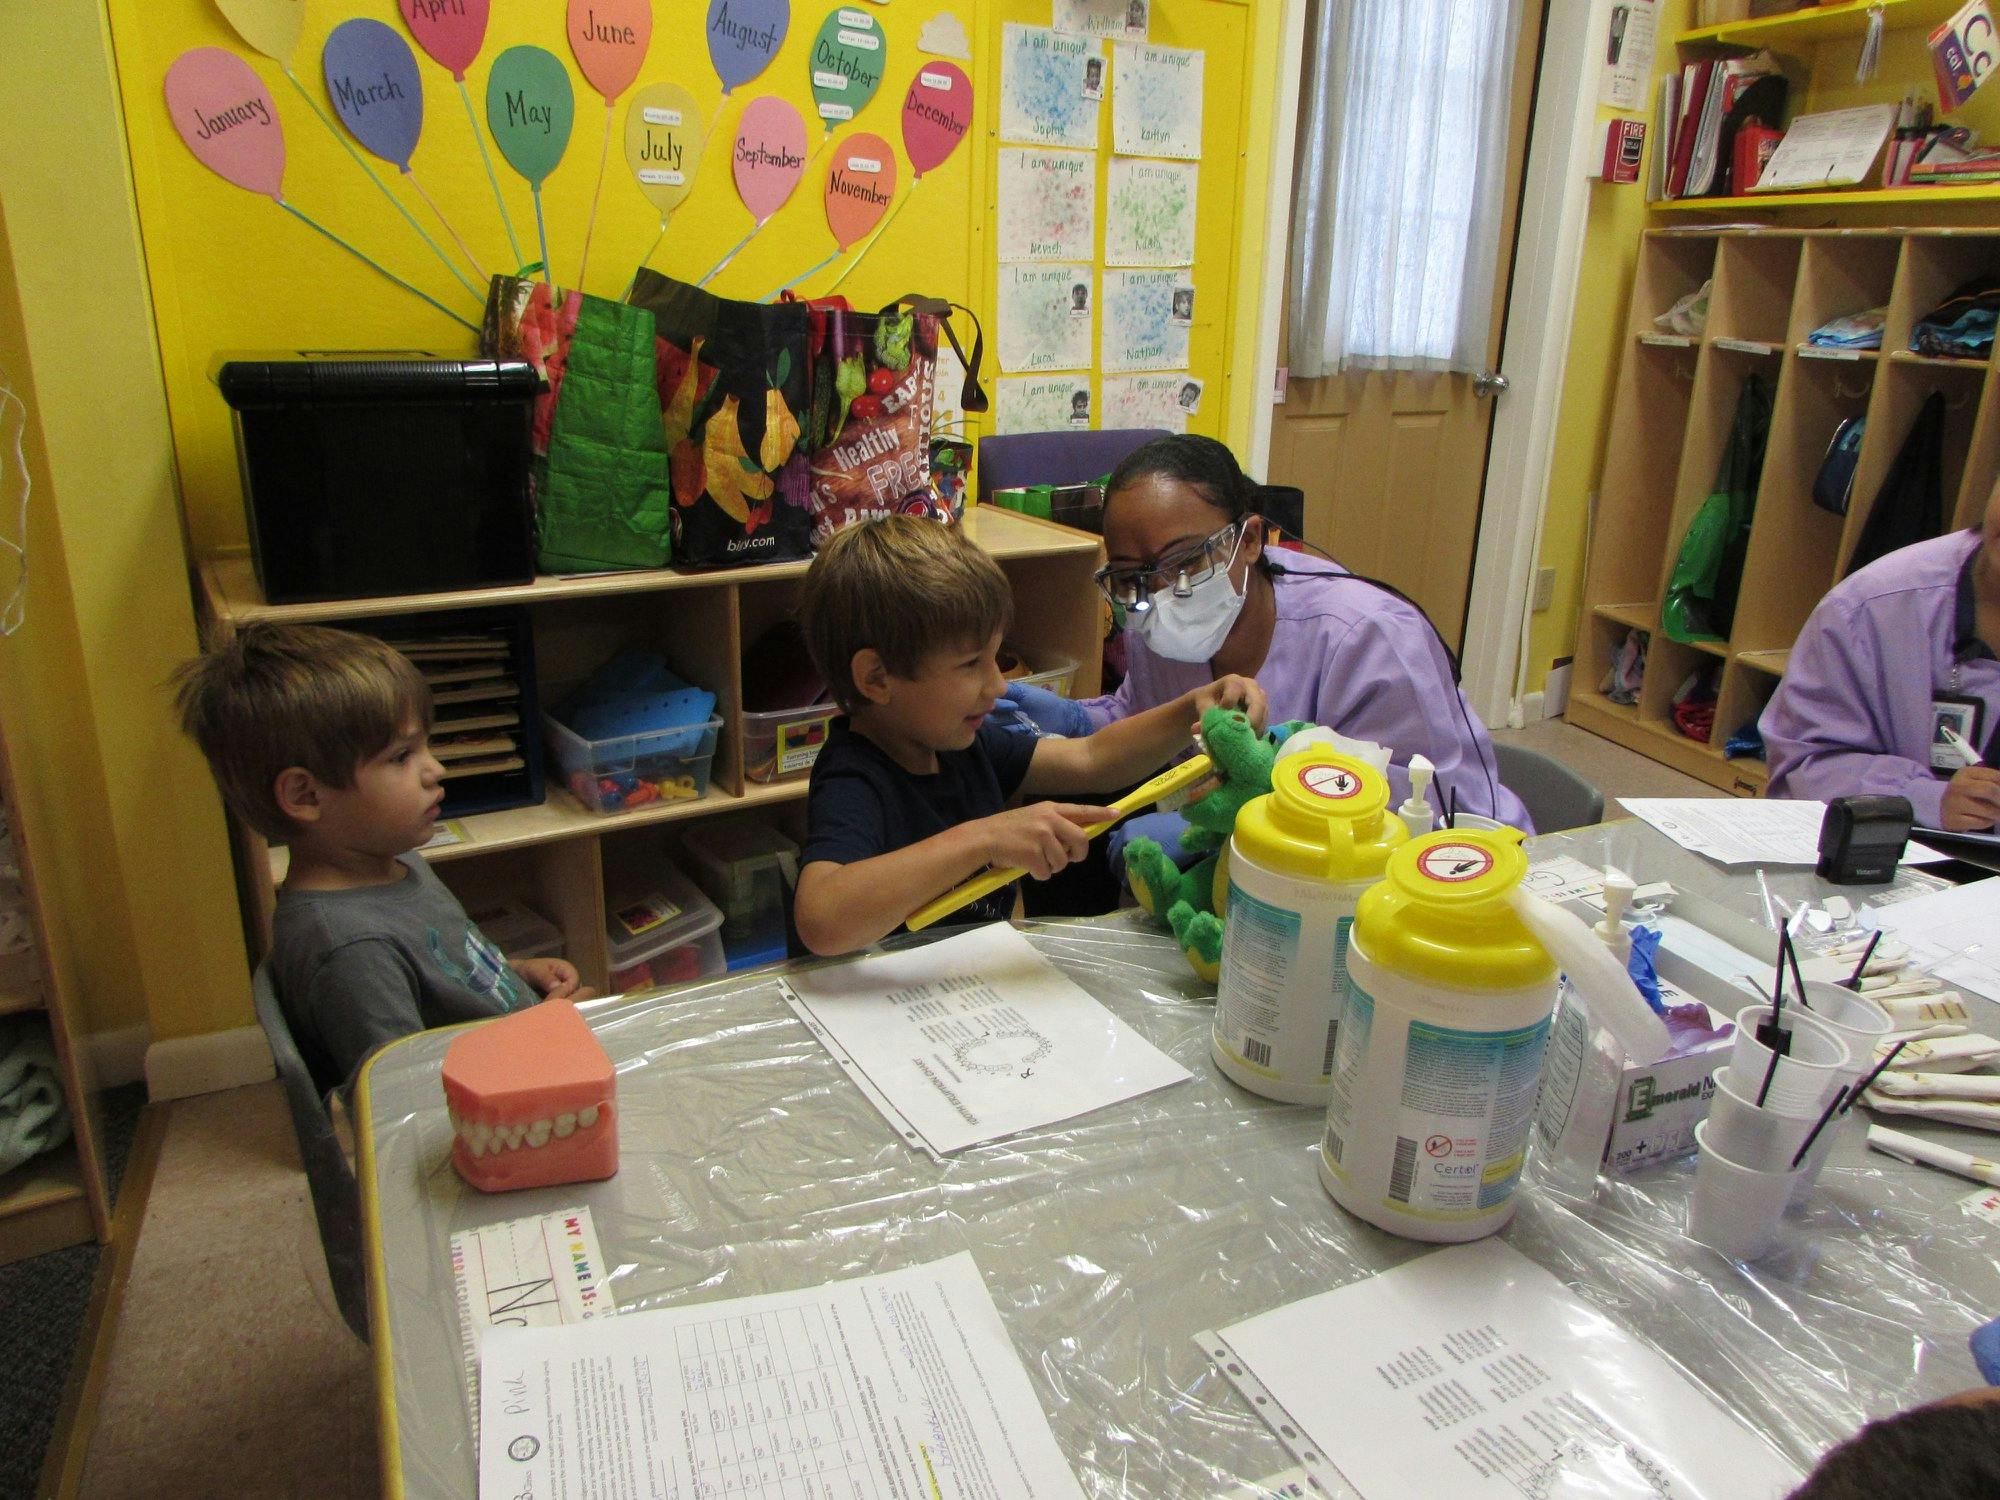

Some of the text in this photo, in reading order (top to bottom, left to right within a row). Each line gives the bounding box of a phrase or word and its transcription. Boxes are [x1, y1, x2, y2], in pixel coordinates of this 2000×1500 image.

[412, 0, 466, 22] April
[583, 10, 636, 45] June
[713, 1, 777, 53] August
[817, 39, 879, 87] October
[1033, 37, 1049, 49] am
[1053, 38, 1087, 59] unique
[1144, 52, 1158, 62] am
[1161, 55, 1191, 72] unique
[333, 73, 404, 117] March
[506, 90, 552, 134] May
[196, 98, 271, 140] January
[907, 90, 964, 136] December
[1623, 122, 1644, 138] FIRE
[641, 130, 682, 171] July
[736, 136, 805, 170] September
[1031, 158, 1048, 170] am
[1052, 160, 1084, 177] unique
[829, 169, 891, 206] November
[1138, 167, 1153, 178] am
[1023, 270, 1038, 283] am
[1041, 269, 1072, 284] unique
[1129, 275, 1146, 285] am
[1150, 272, 1178, 288] unique
[1031, 384, 1047, 397] am
[1048, 382, 1076, 400] unique
[833, 427, 901, 472] Healthy
[1021, 1068, 1035, 1080] R
[1624, 1076, 1701, 1122] Emerald
[564, 1216, 582, 1238] MY
[569, 1240, 592, 1282] NAME
[497, 1369, 531, 1417] Pink
